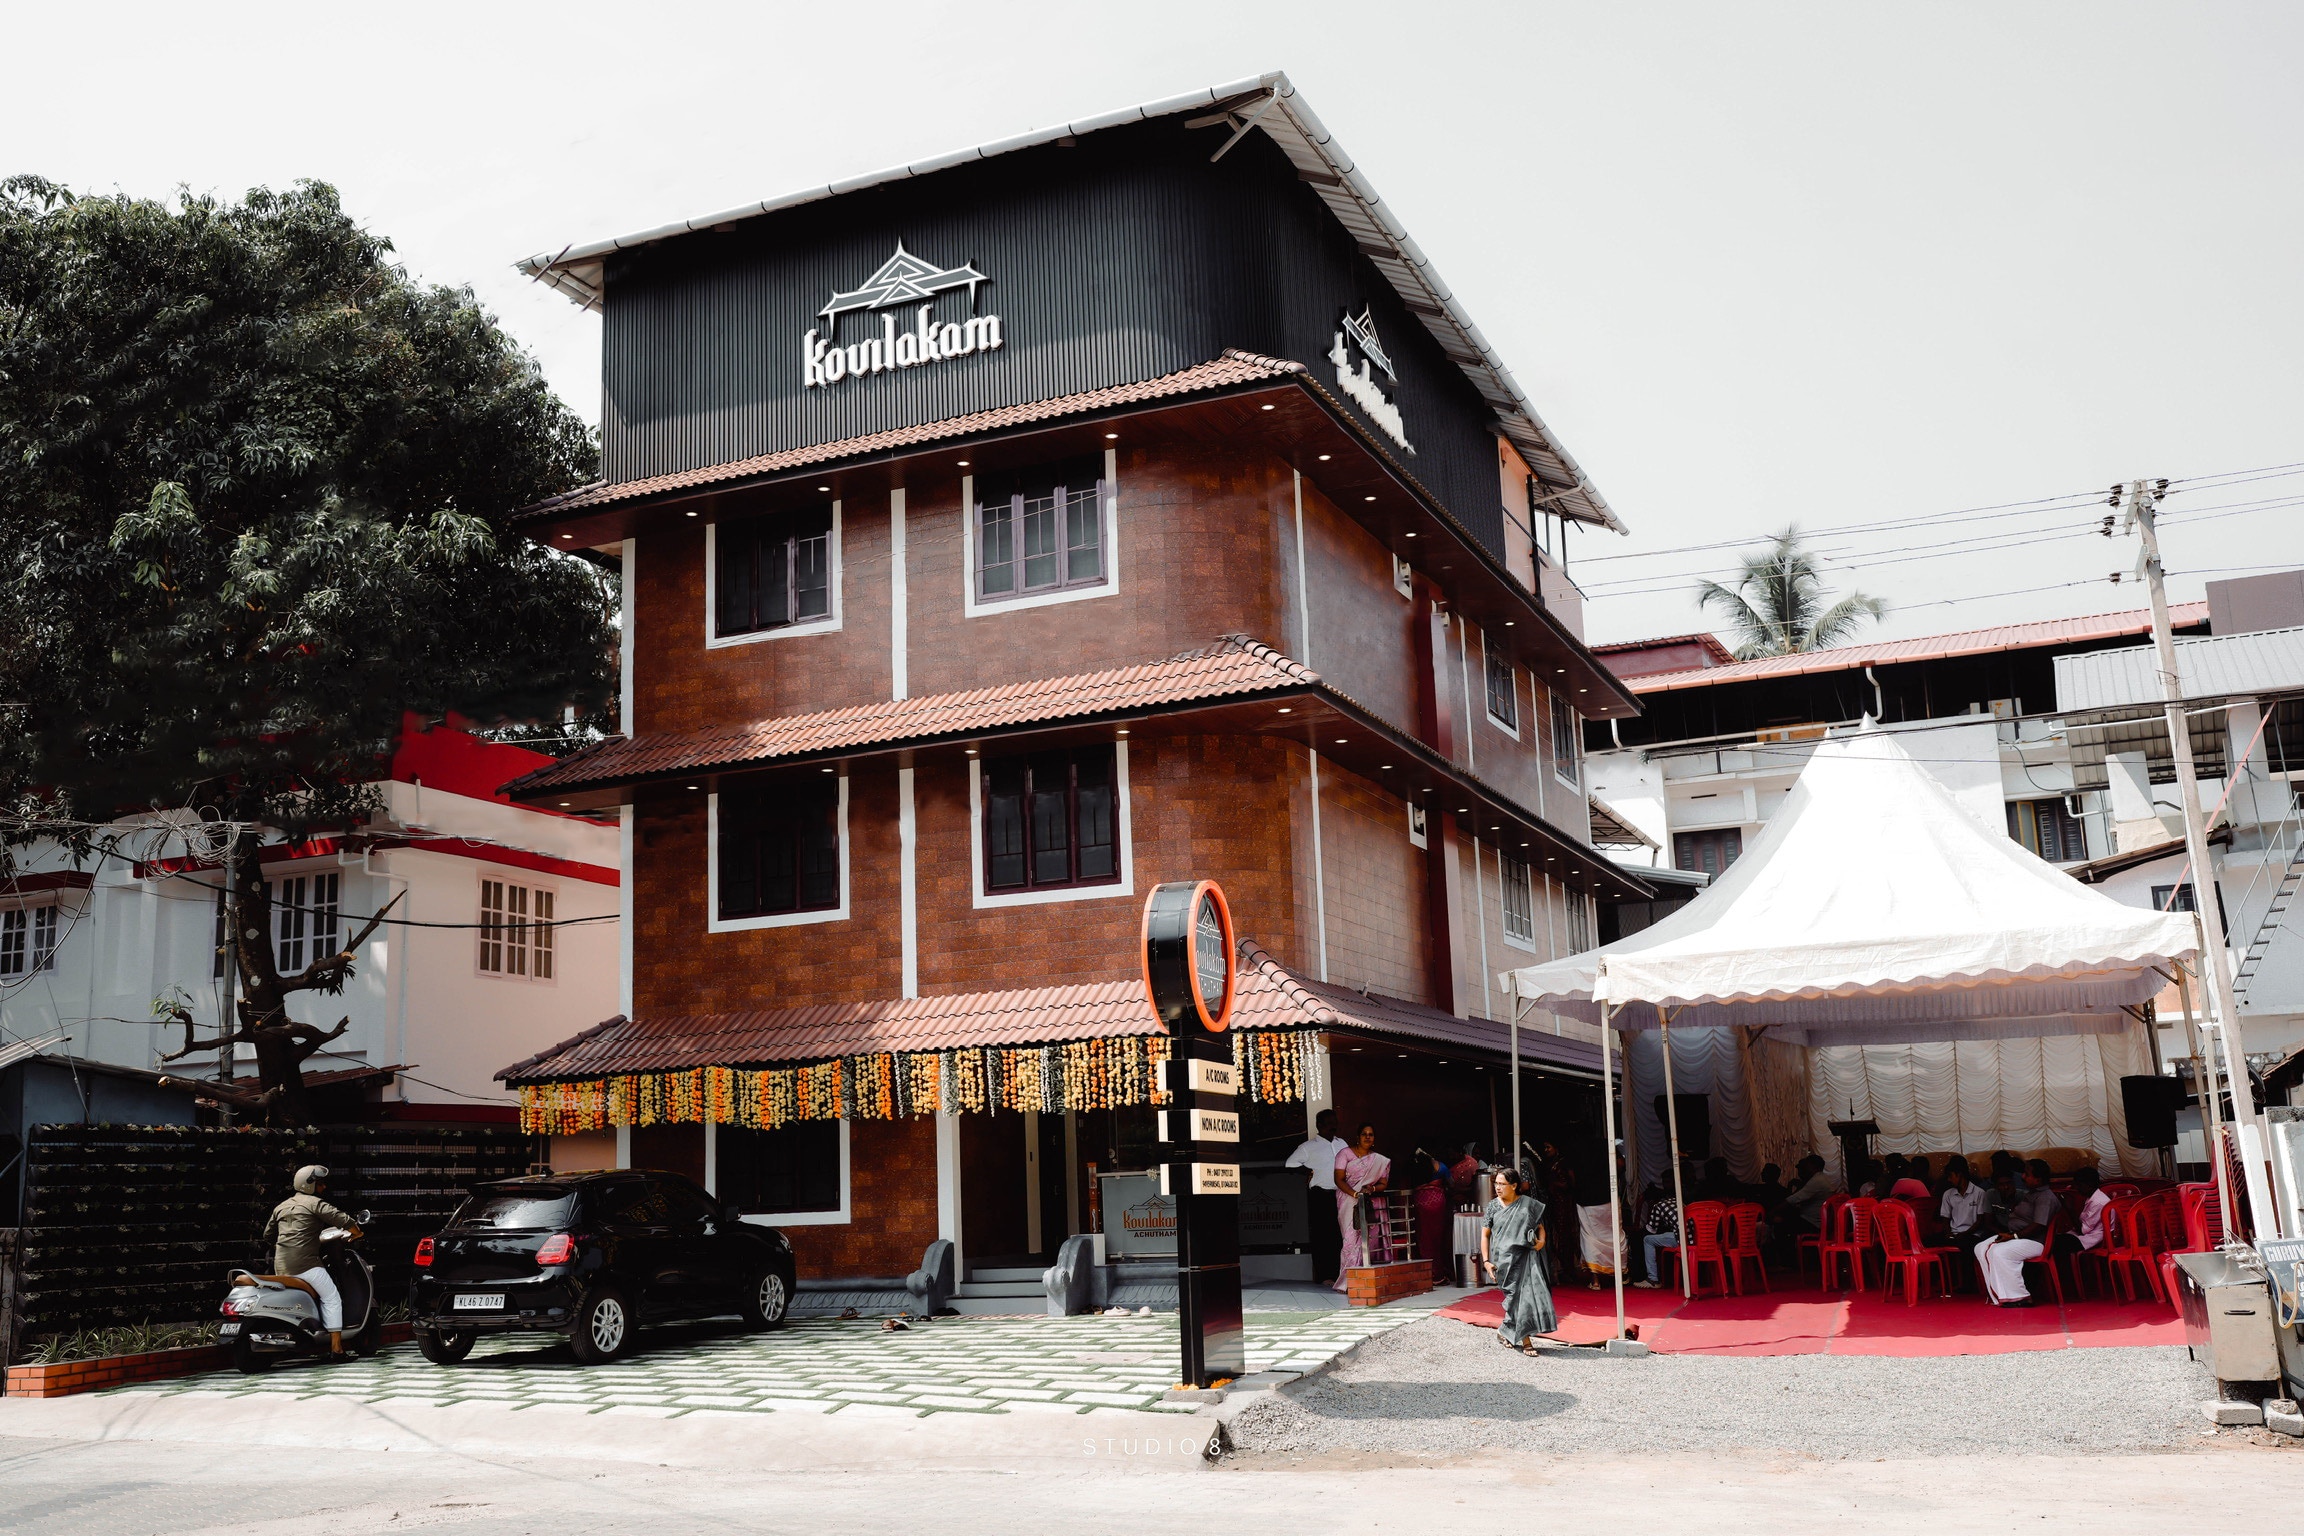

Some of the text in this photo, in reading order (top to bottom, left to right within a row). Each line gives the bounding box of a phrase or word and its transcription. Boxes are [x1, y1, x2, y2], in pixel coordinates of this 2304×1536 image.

[1214, 1070, 1230, 1084] ROOMS
[1202, 1117, 1213, 1131] NON
[1221, 1119, 1236, 1133] ROOMS
